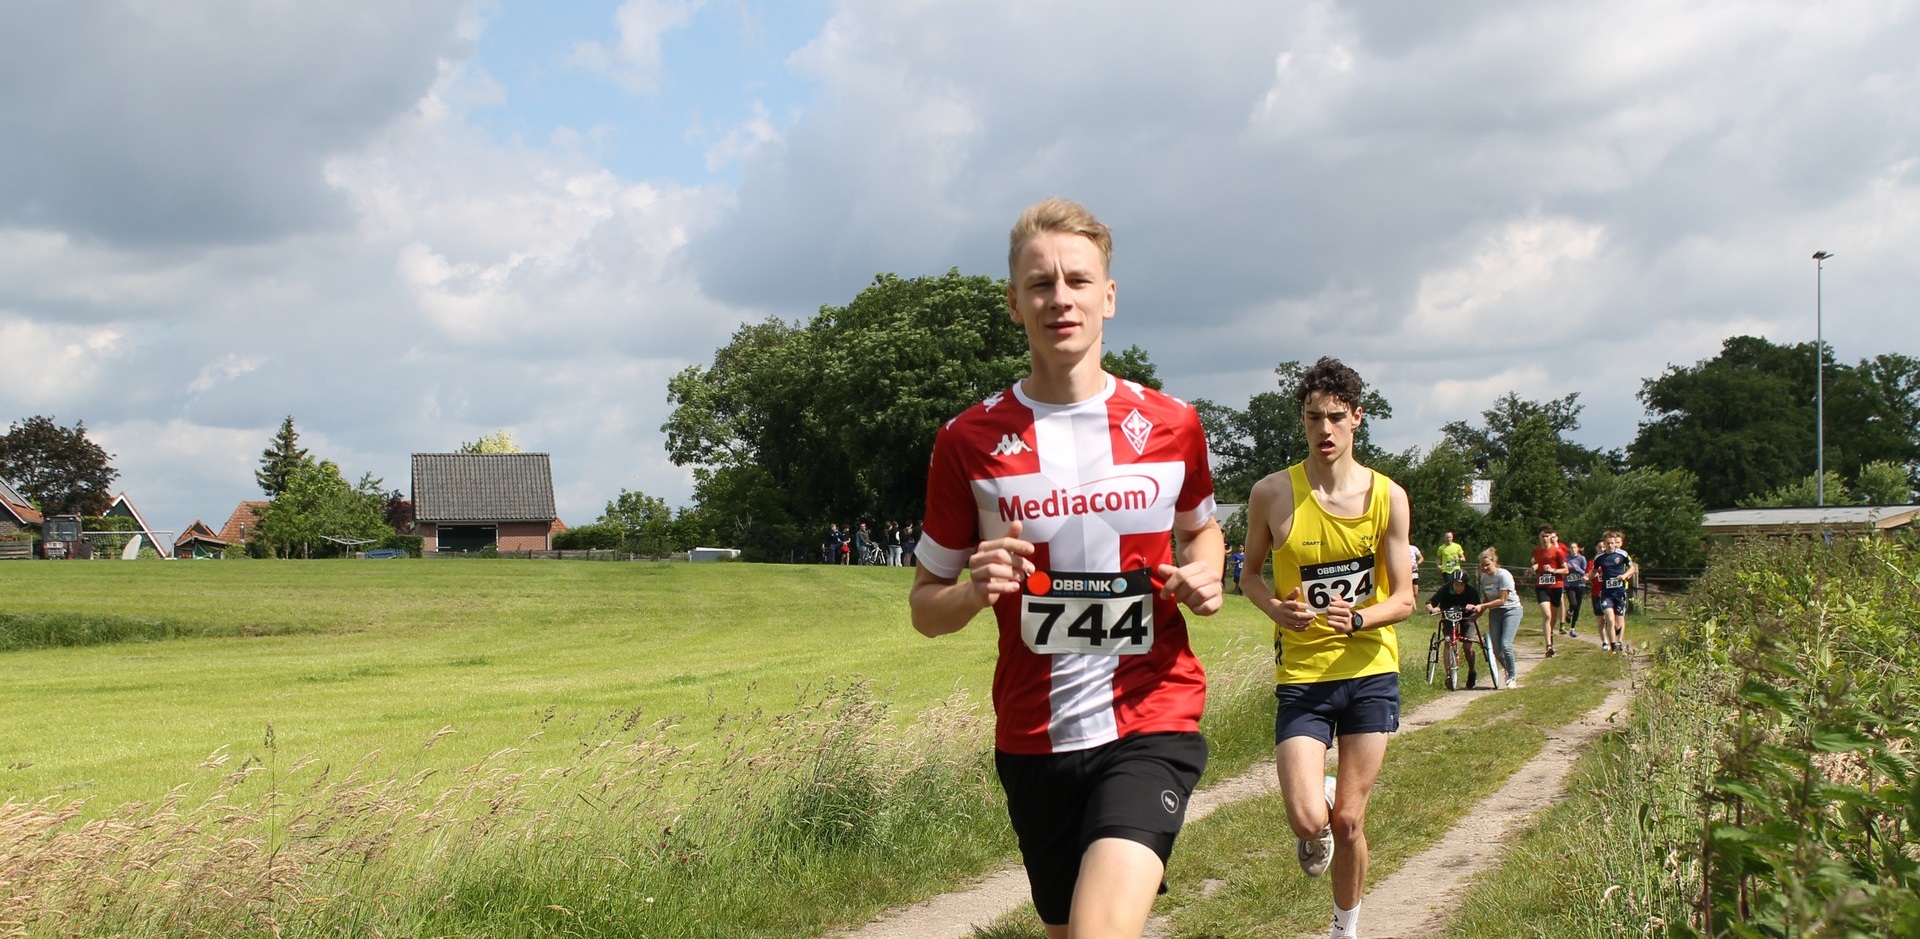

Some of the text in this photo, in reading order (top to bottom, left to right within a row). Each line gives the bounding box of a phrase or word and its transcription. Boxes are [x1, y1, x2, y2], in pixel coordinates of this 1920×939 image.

[998, 488, 1146, 522] Mediacom
[1307, 571, 1373, 609] 624
[1540, 576, 1555, 584] 586
[1028, 601, 1148, 646] 744
